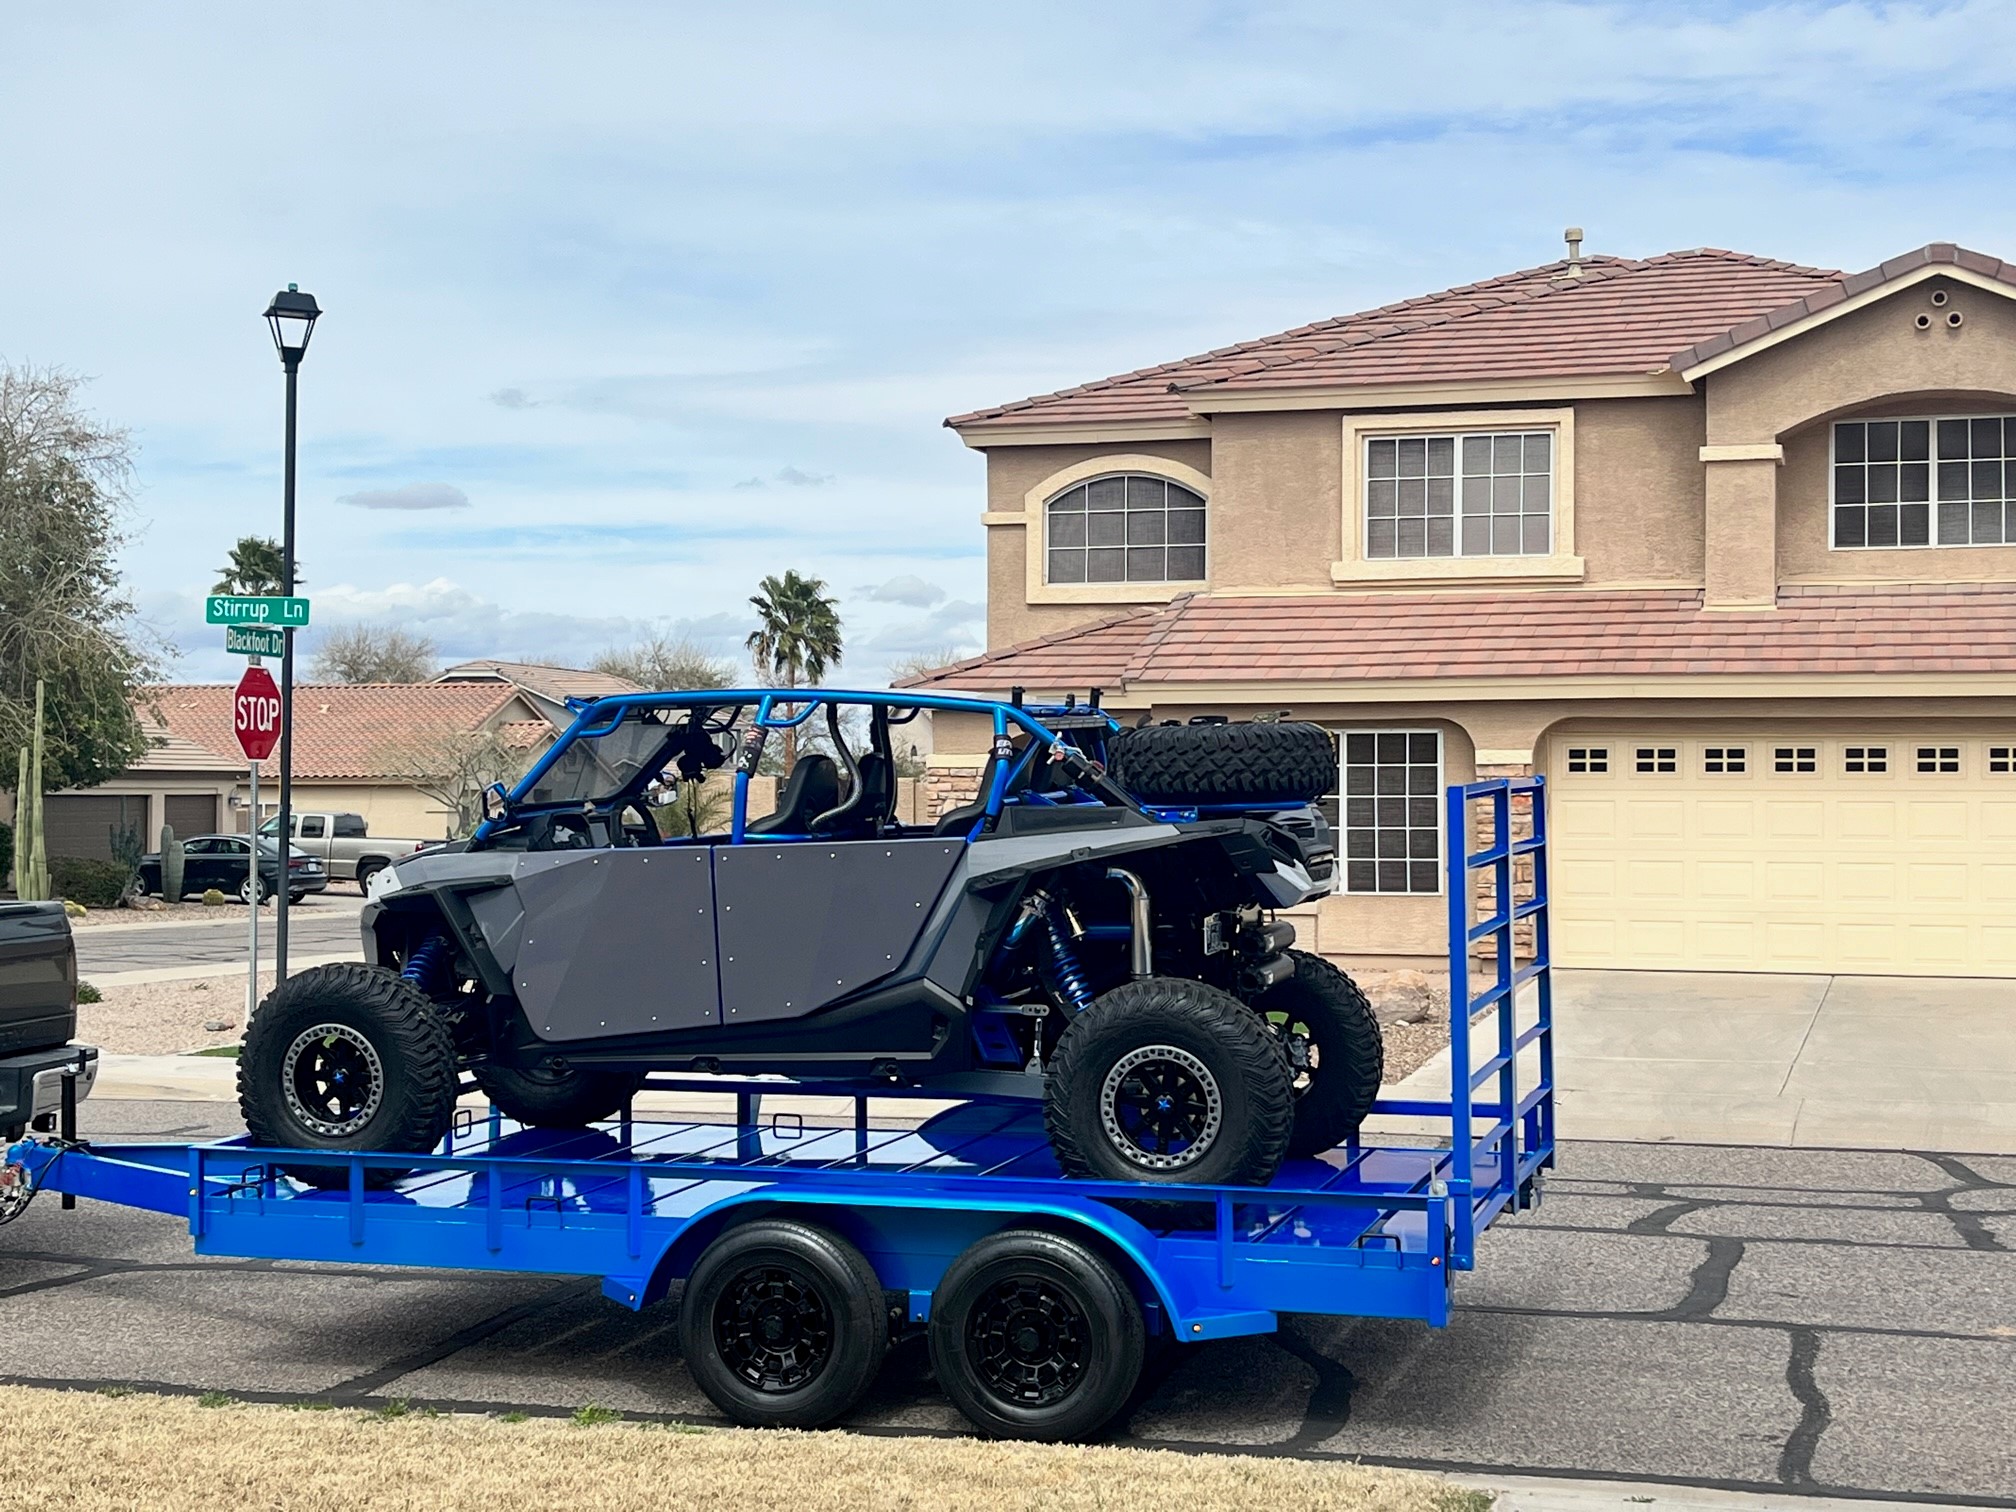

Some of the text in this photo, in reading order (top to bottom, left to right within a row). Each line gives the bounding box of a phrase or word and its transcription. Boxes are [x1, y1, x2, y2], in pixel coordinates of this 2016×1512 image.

[213, 599, 302, 622] Stirrup Ln
[227, 629, 283, 654] Blackfoot Dr
[237, 695, 279, 732] STOP
